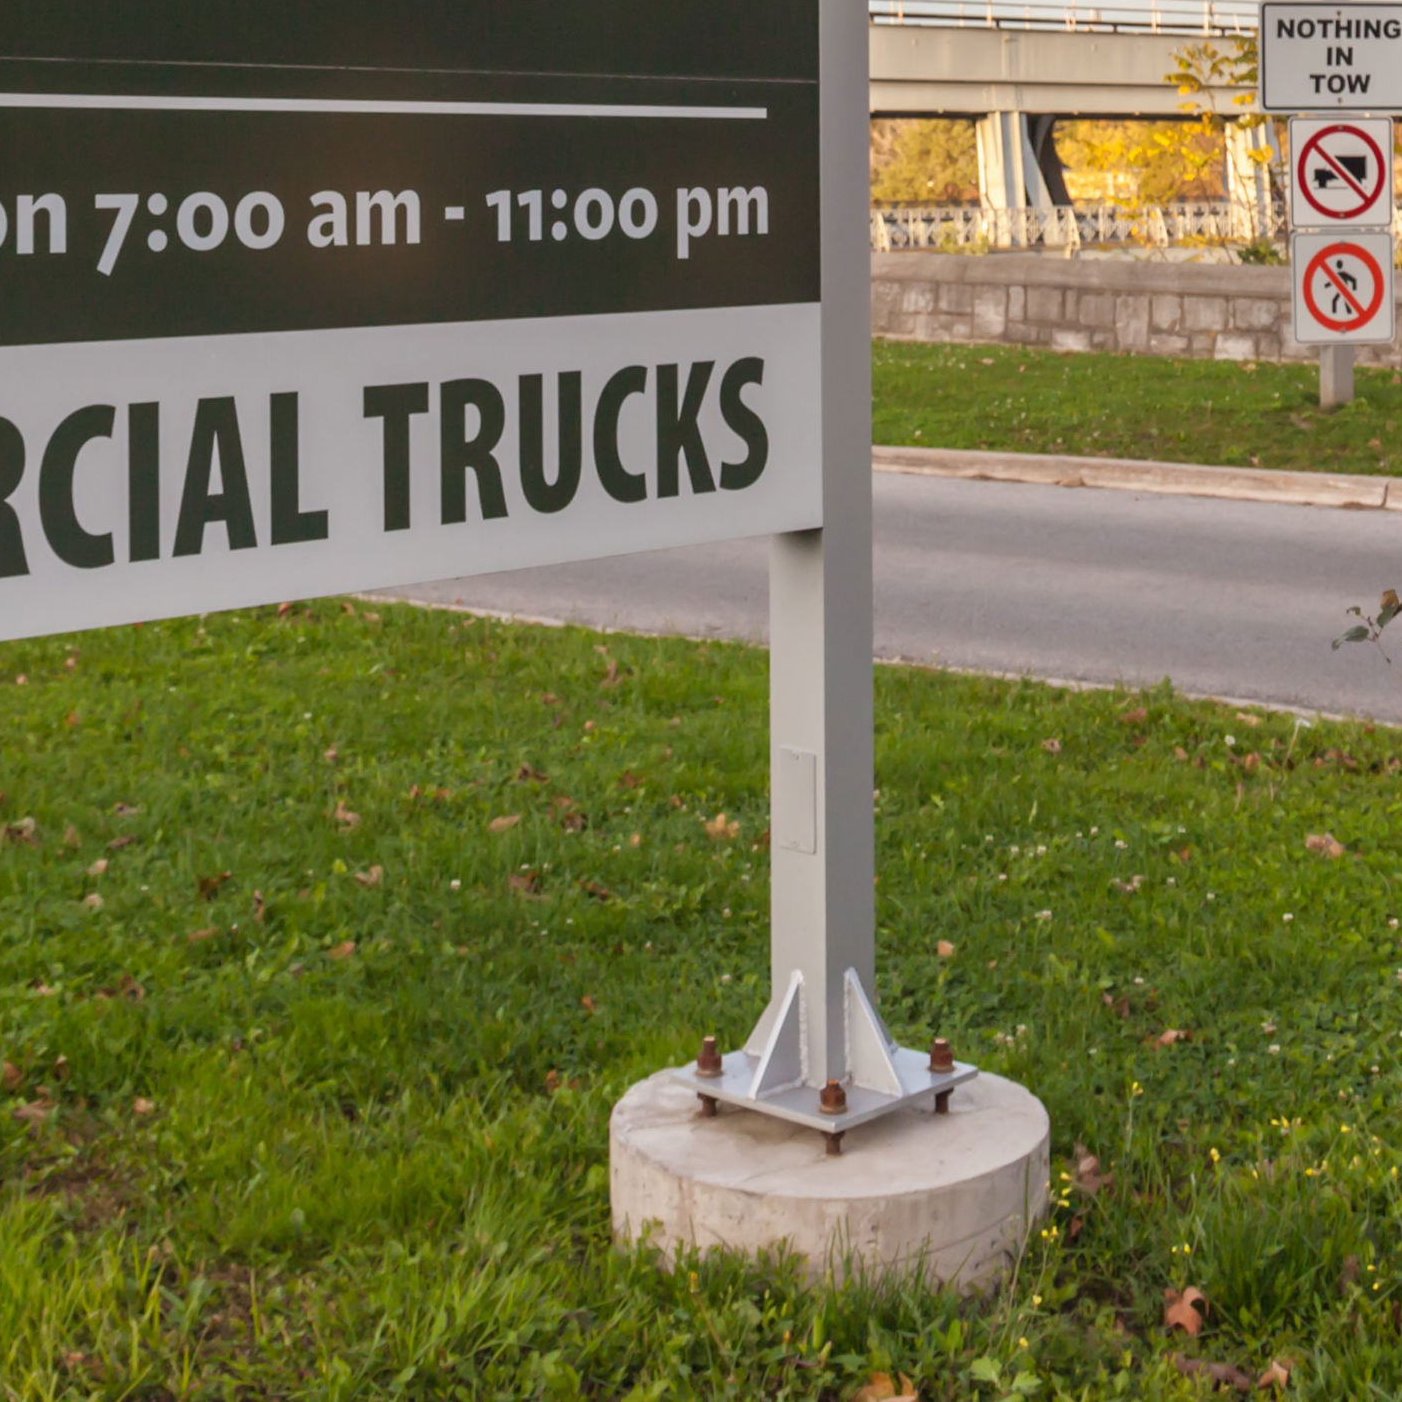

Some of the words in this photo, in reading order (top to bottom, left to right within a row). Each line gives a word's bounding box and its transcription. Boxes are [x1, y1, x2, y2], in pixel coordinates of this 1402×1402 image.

[1276, 18, 1402, 40] NOTHING
[1326, 46, 1354, 67] IN
[1309, 74, 1371, 94] TOW
[95, 191, 285, 276] 7:00
[307, 189, 421, 248] am
[444, 206, 465, 220] -
[485, 188, 658, 242] 11:00
[677, 186, 768, 259] pm
[362, 356, 769, 533] TRUCKS
